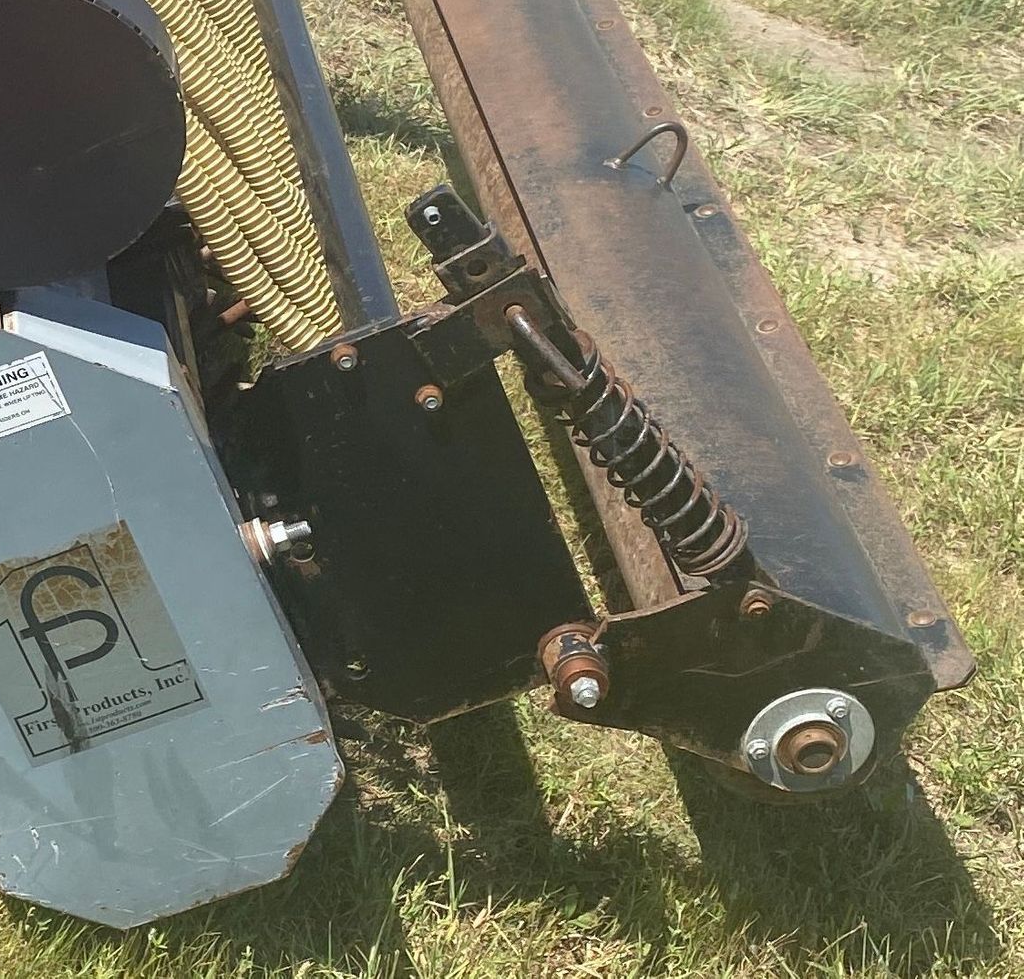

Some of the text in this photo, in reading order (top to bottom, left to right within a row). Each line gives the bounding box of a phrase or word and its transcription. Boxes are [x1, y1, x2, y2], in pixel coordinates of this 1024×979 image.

[9, 381, 40, 397] HAZARD
[23, 715, 63, 736] Firs
[155, 673, 190, 692] Inc.
